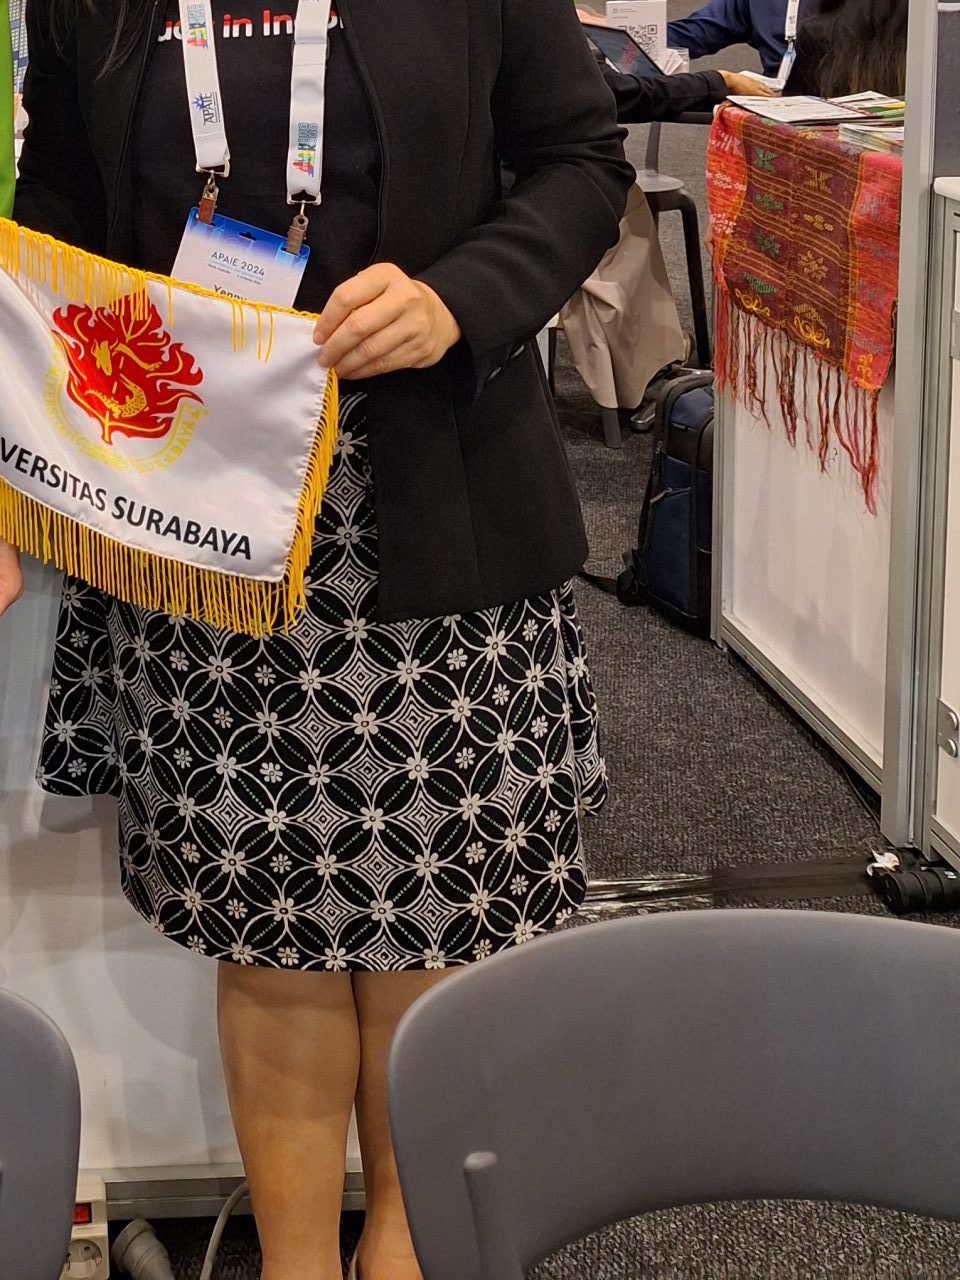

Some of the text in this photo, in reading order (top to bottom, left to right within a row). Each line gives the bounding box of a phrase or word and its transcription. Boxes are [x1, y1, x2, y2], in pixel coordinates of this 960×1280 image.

[223, 14, 253, 38] in
[211, 251, 240, 267] APAIE
[241, 261, 265, 276] 2024
[111, 496, 251, 560] SURABAYA
